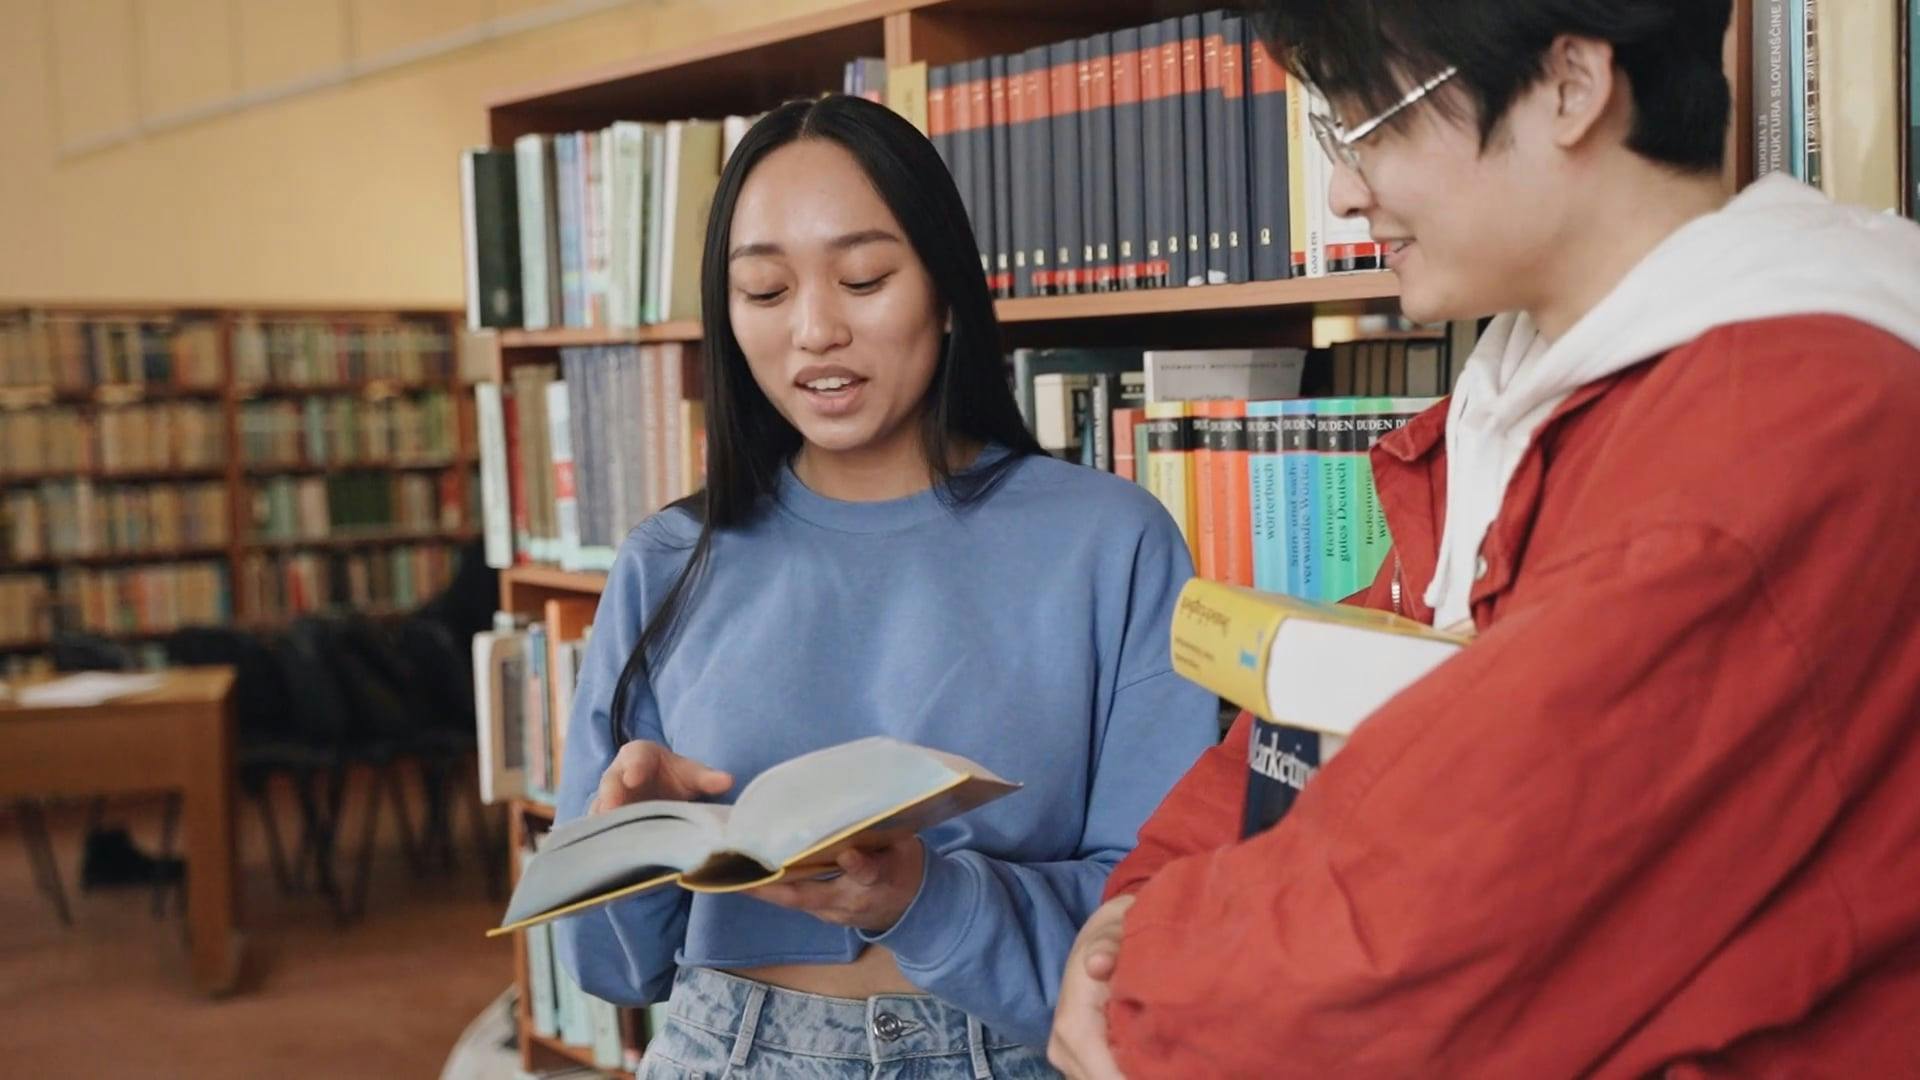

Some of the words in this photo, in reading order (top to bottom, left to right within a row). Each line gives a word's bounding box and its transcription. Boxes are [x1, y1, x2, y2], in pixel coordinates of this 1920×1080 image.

[1768, 4, 1782, 97] SLOVENŠČINE
[1770, 100, 1781, 172] TRUKTURA
[1247, 421, 1281, 432] DUDEN
[1282, 419, 1316, 431] DUDEN
[1318, 420, 1353, 432] DUDEN
[1356, 419, 1392, 431] DUDEN
[1324, 462, 1333, 490] und
[1336, 462, 1347, 520] Deutsch
[1264, 462, 1276, 540] wörterbuch
[1289, 500, 1298, 527] und
[1325, 494, 1336, 557] Richtiges
[1338, 525, 1350, 562] gutes
[1301, 514, 1312, 584] verwandte
